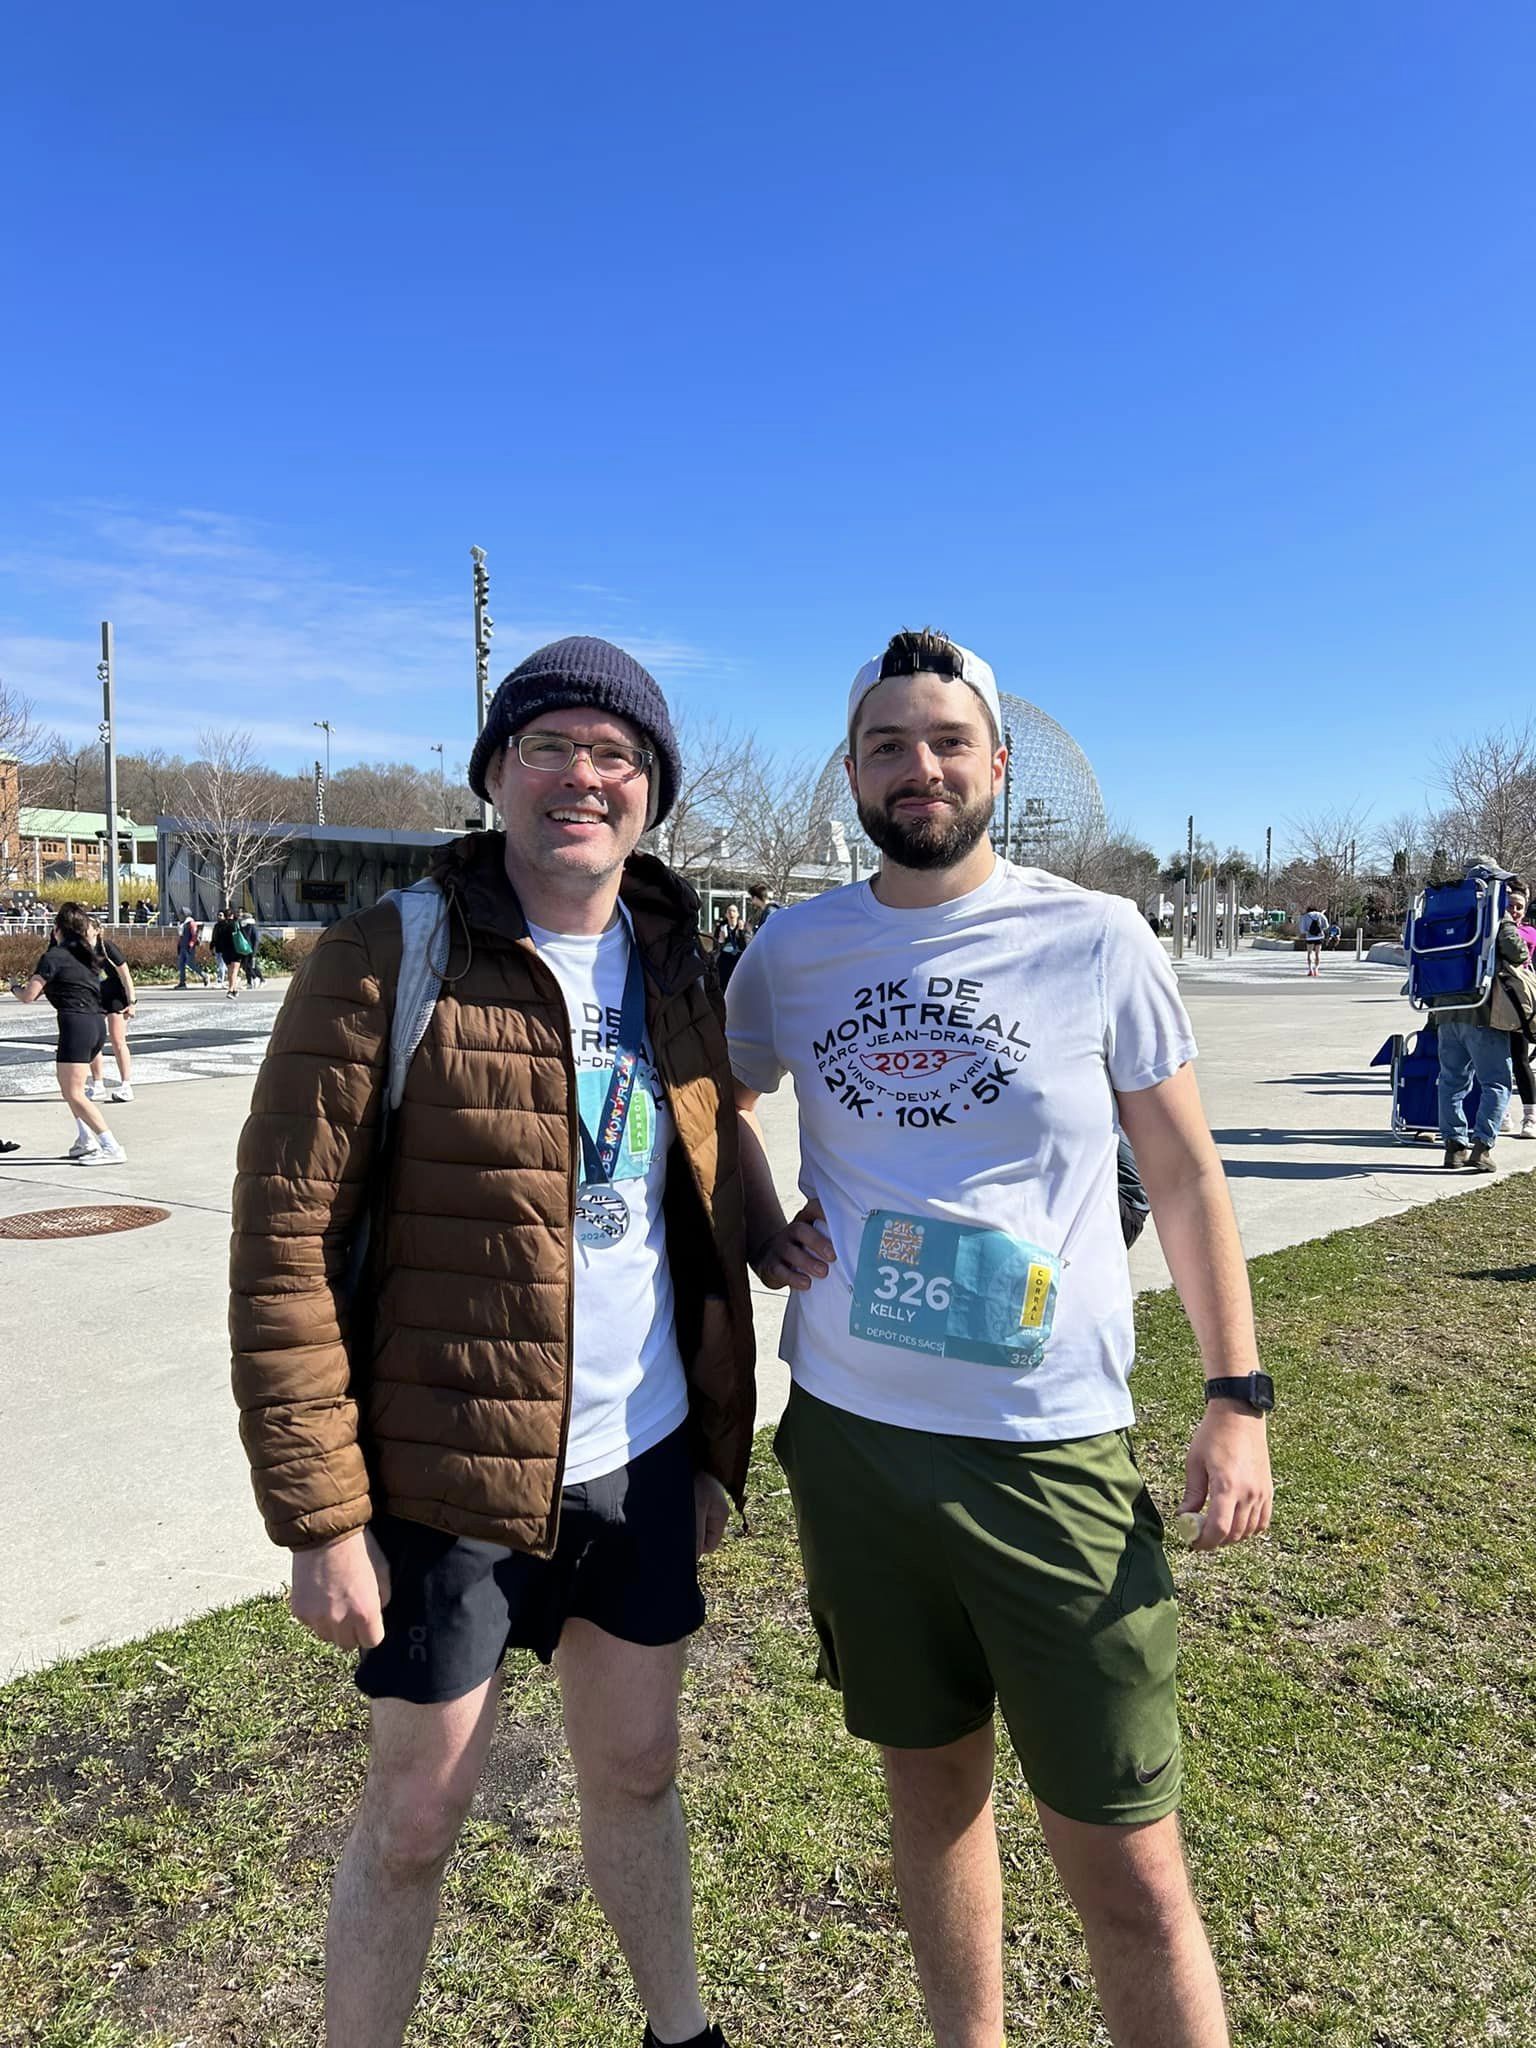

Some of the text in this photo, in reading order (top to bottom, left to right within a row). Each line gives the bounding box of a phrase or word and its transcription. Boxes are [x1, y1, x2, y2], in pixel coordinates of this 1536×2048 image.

[854, 976, 983, 1010] 21K DE
[812, 1001, 1032, 1060] MONTRÉAL
[817, 1029, 1028, 1073] PARC JEAN-DRAPEAU
[847, 1055, 988, 1102] VINGT-DEUX AVRIL
[875, 1051, 948, 1072] 2023
[824, 1058, 1019, 1128] 21K 10K 5K
[633, 1095, 643, 1148] CORRAL
[874, 1265, 953, 1311] 326
[1030, 1270, 1043, 1321] CORRAL
[870, 1302, 916, 1323] KELLY
[899, 1334, 917, 1346] DES
[917, 1339, 943, 1352] SACS
